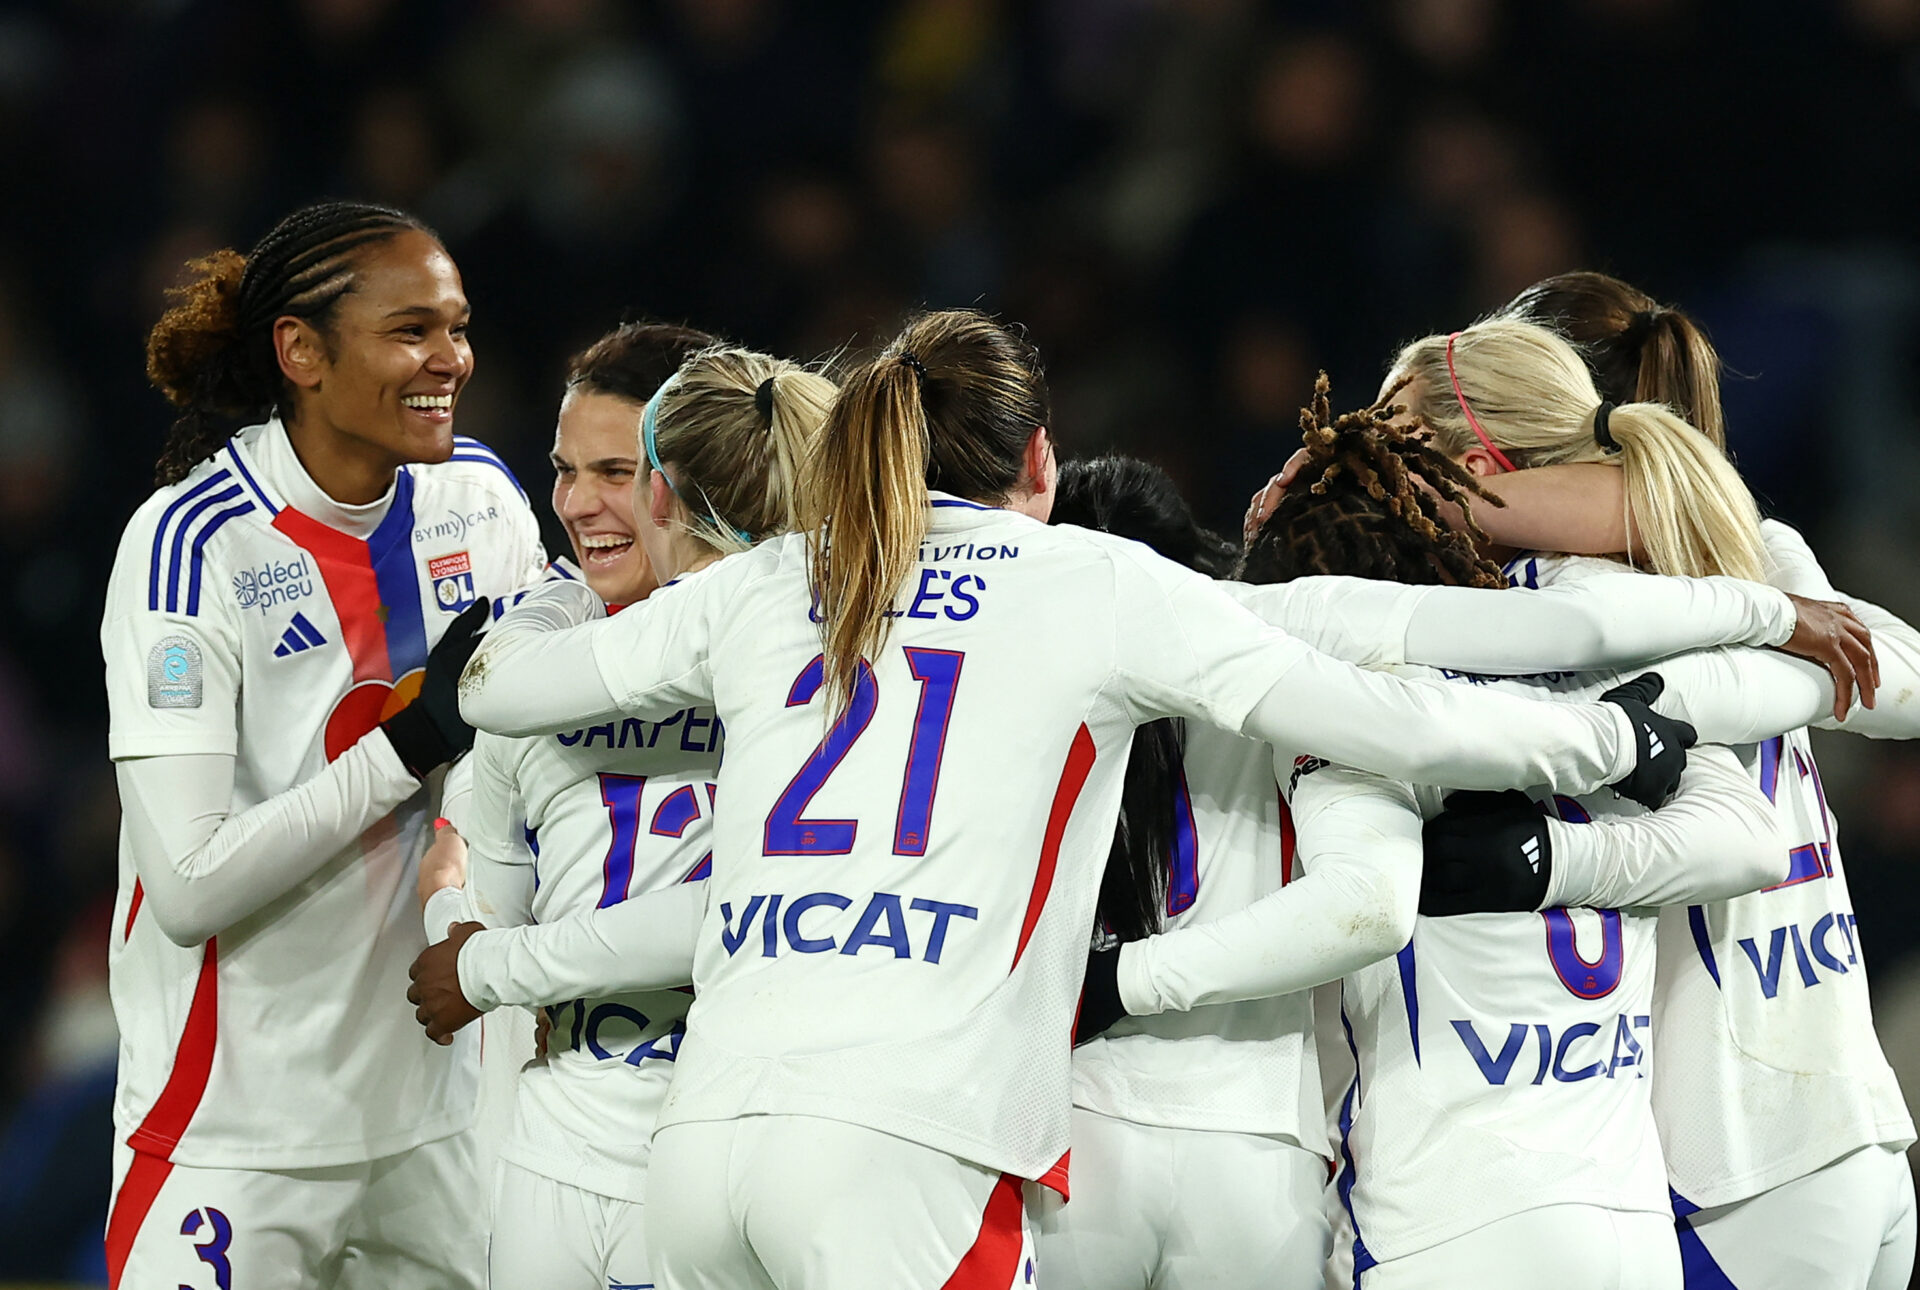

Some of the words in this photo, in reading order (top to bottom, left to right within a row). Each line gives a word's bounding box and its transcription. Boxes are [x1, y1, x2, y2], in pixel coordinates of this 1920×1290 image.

[259, 578, 313, 617] pneu
[762, 645, 966, 858] 21
[719, 891, 979, 966] VICAT
[544, 997, 687, 1068] VICA
[179, 1205, 233, 1290] 3
